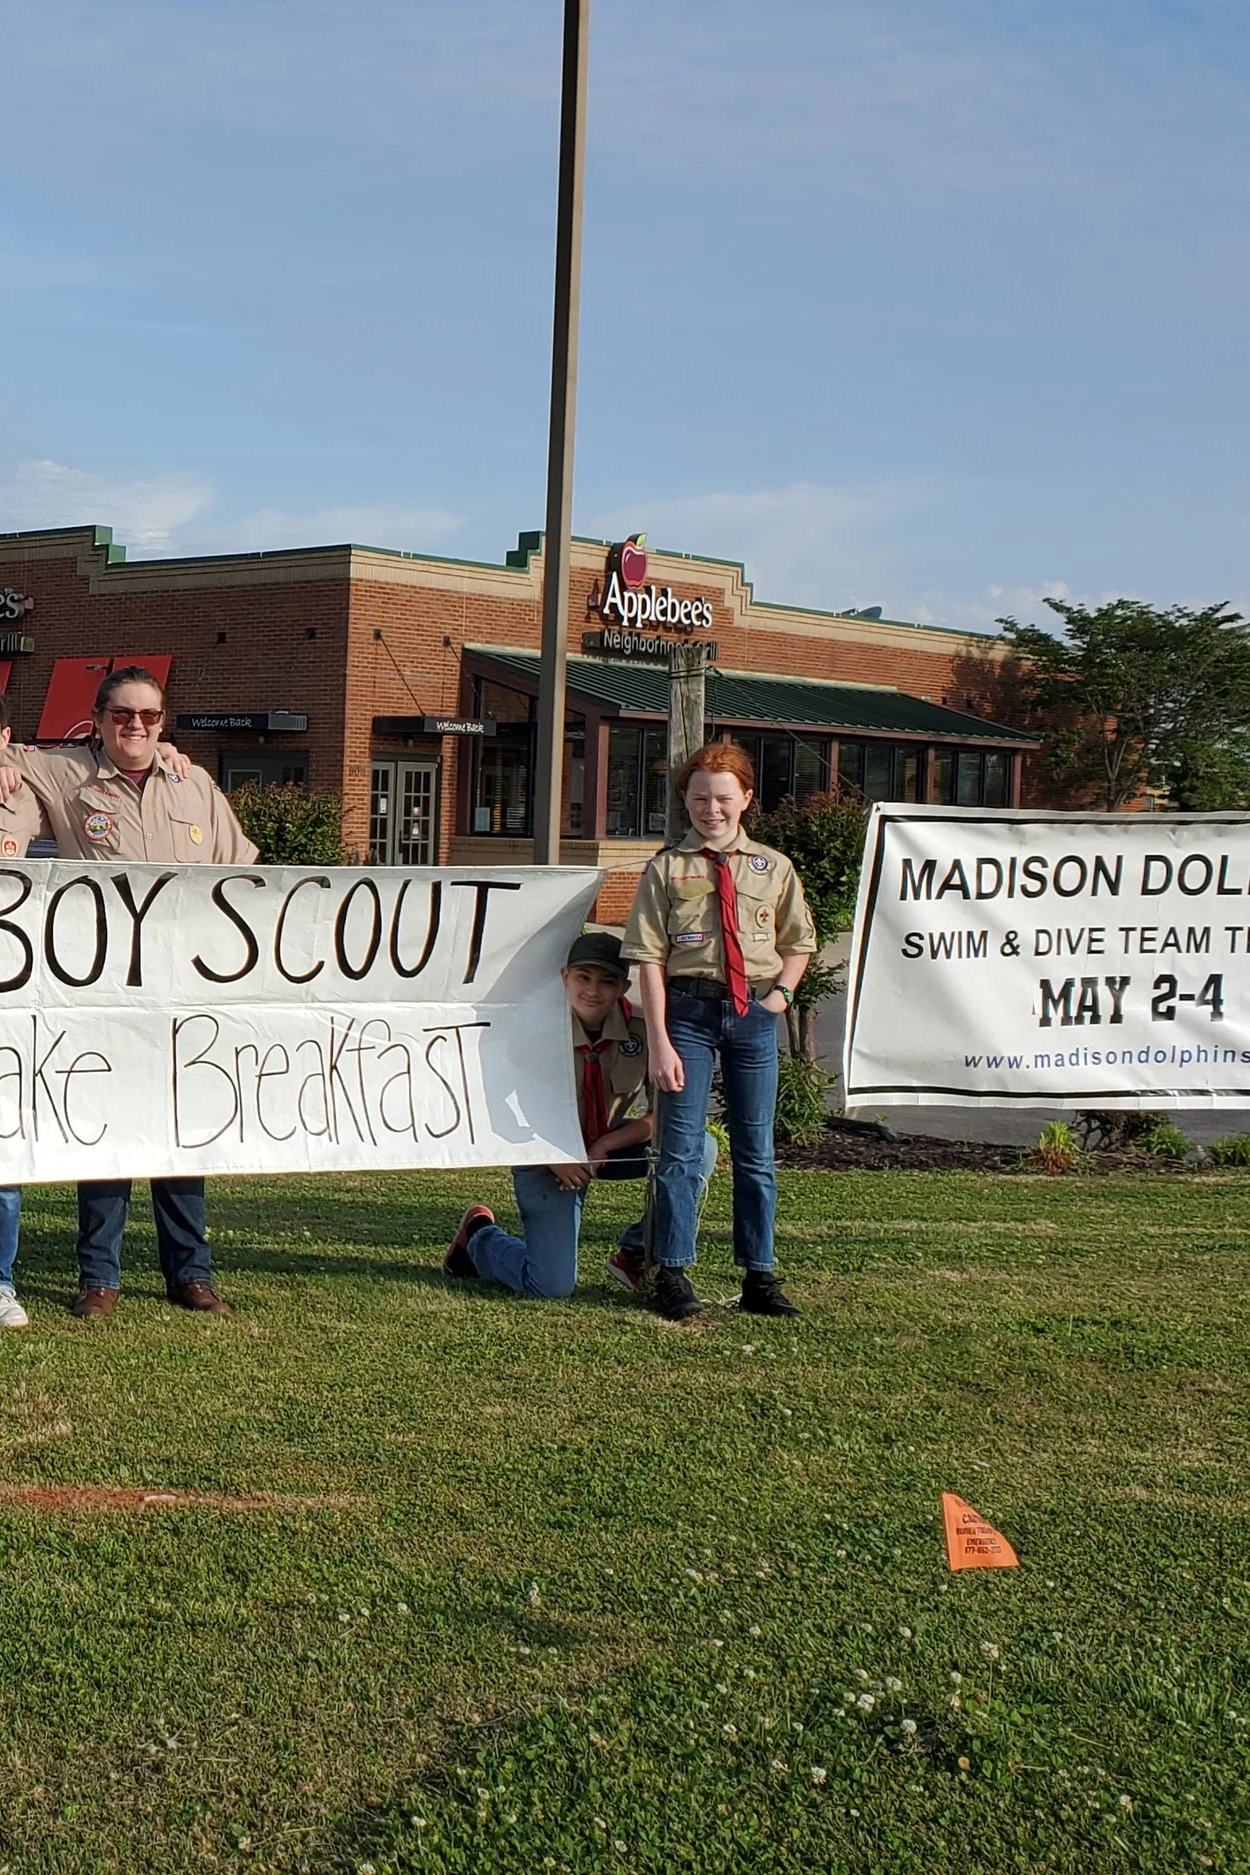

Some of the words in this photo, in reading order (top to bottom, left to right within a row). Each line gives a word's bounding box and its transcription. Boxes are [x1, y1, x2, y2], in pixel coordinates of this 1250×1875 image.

[603, 571, 713, 628] Applebee's
[191, 717, 228, 728] Welcome
[229, 716, 253, 728] Back
[436, 720, 466, 732] Welcome
[466, 722, 485, 733] Back
[899, 854, 1124, 901] MADISON
[1140, 853, 1250, 897] DOL
[191, 873, 522, 985] SCOUT
[901, 930, 989, 960] SWIM
[1000, 930, 1021, 957] &
[1034, 928, 1106, 957] DIVE
[1119, 926, 1211, 954] TEAM
[1039, 976, 1131, 1027] MAY
[1151, 974, 1224, 1022] 2-4
[964, 1044, 1250, 1070] www.madisondolphins
